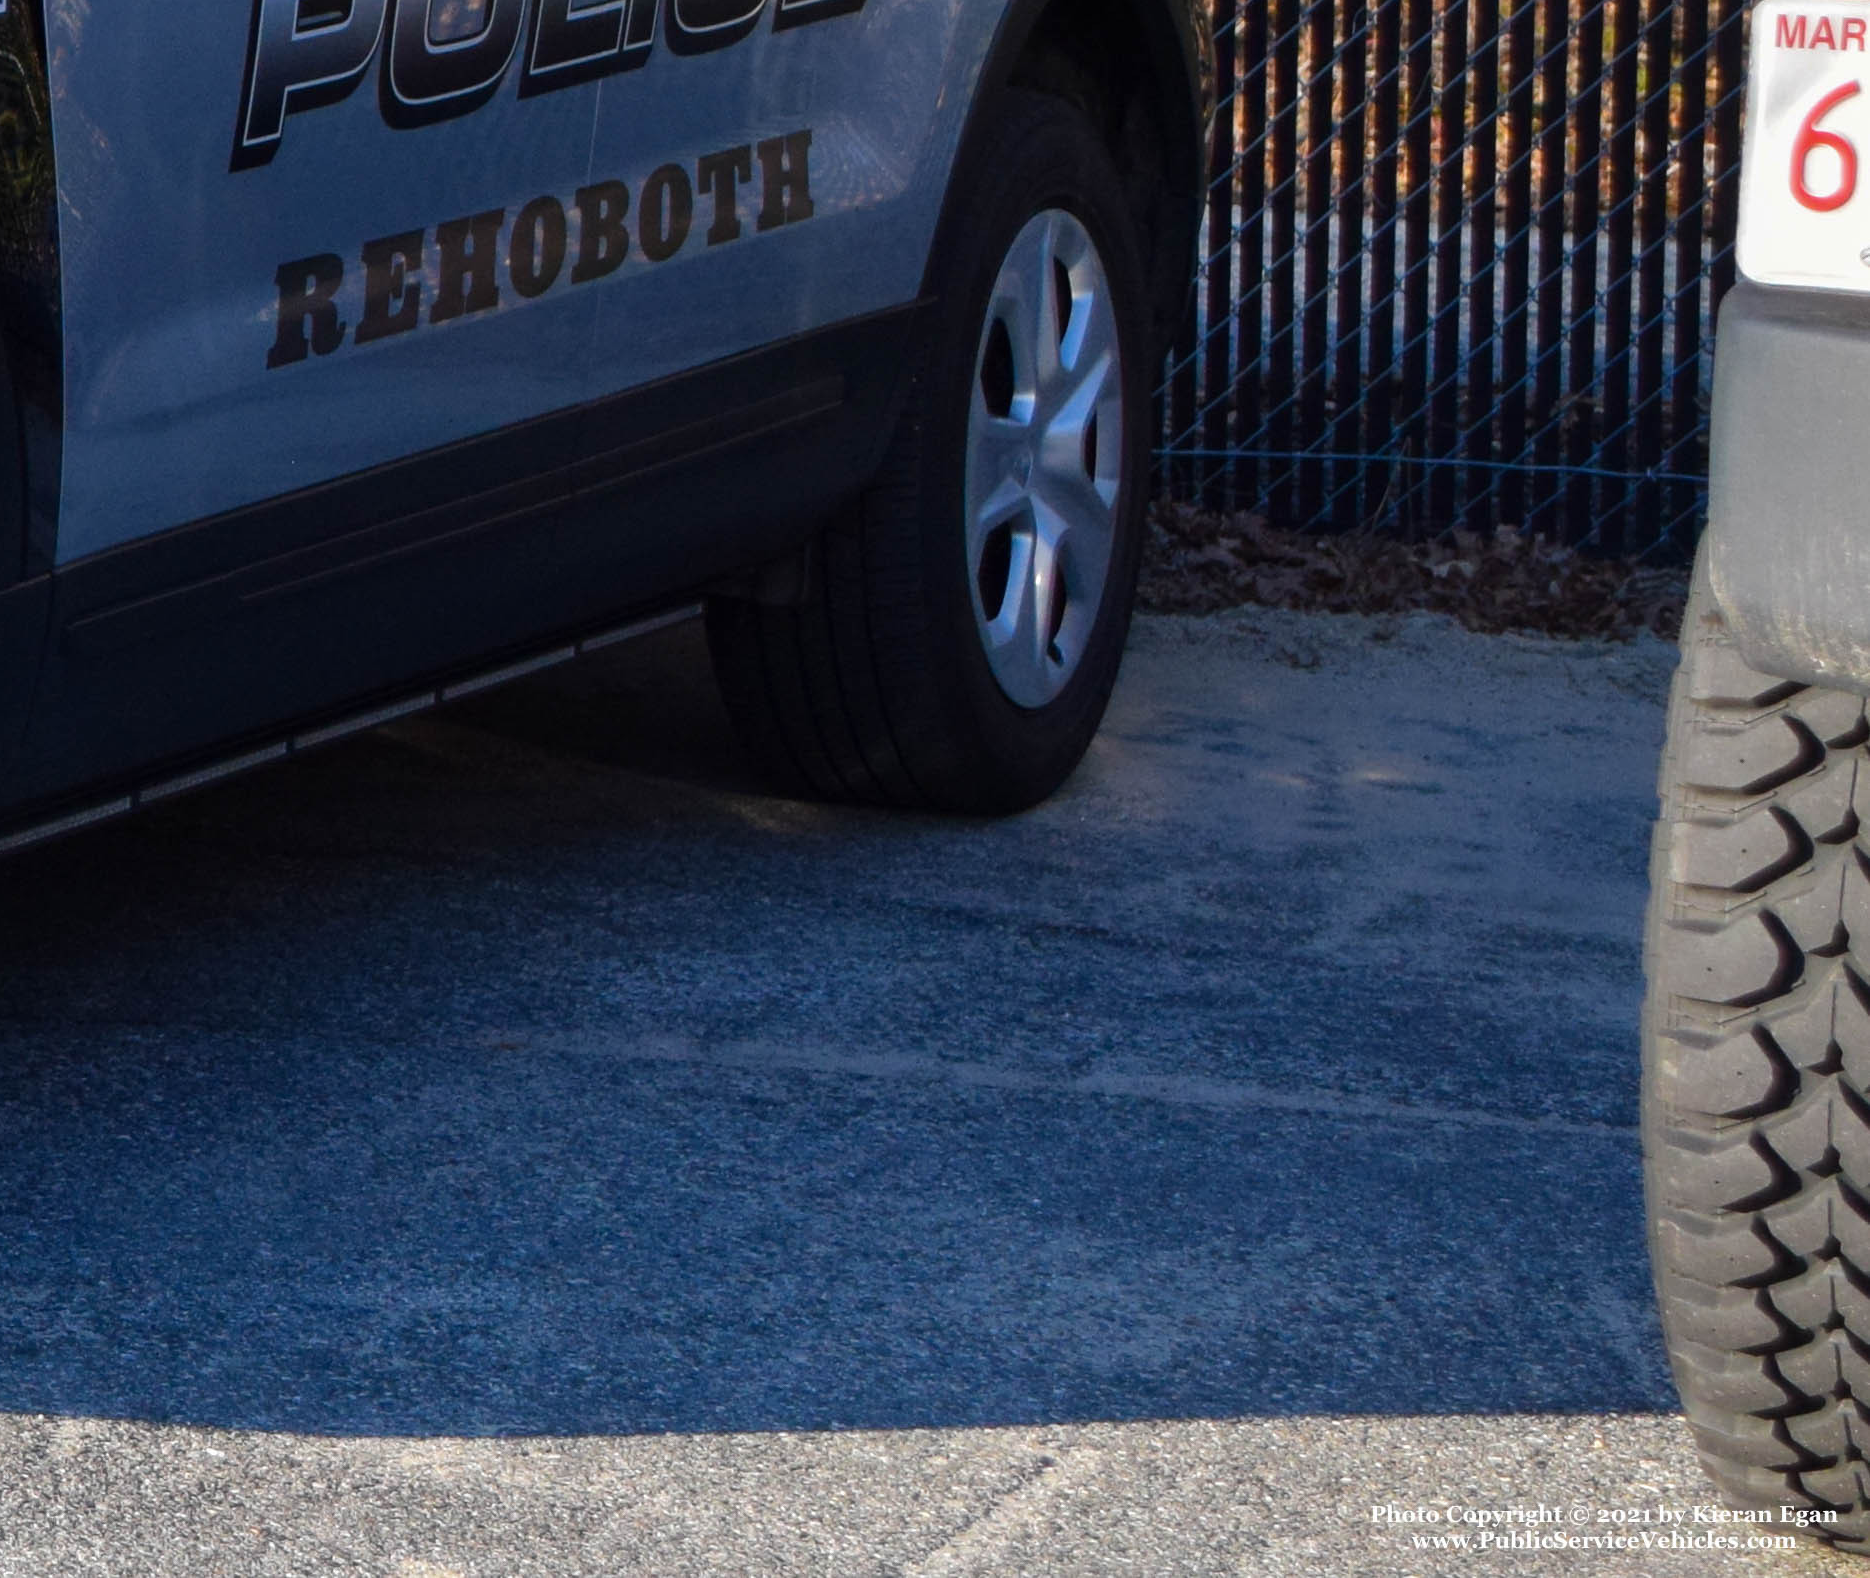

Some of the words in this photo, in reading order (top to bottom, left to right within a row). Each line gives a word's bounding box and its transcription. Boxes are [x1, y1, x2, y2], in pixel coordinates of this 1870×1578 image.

[1774, 13, 1867, 52] MAR
[1788, 78, 1861, 213] 6
[265, 129, 815, 370] REHOBOTH
